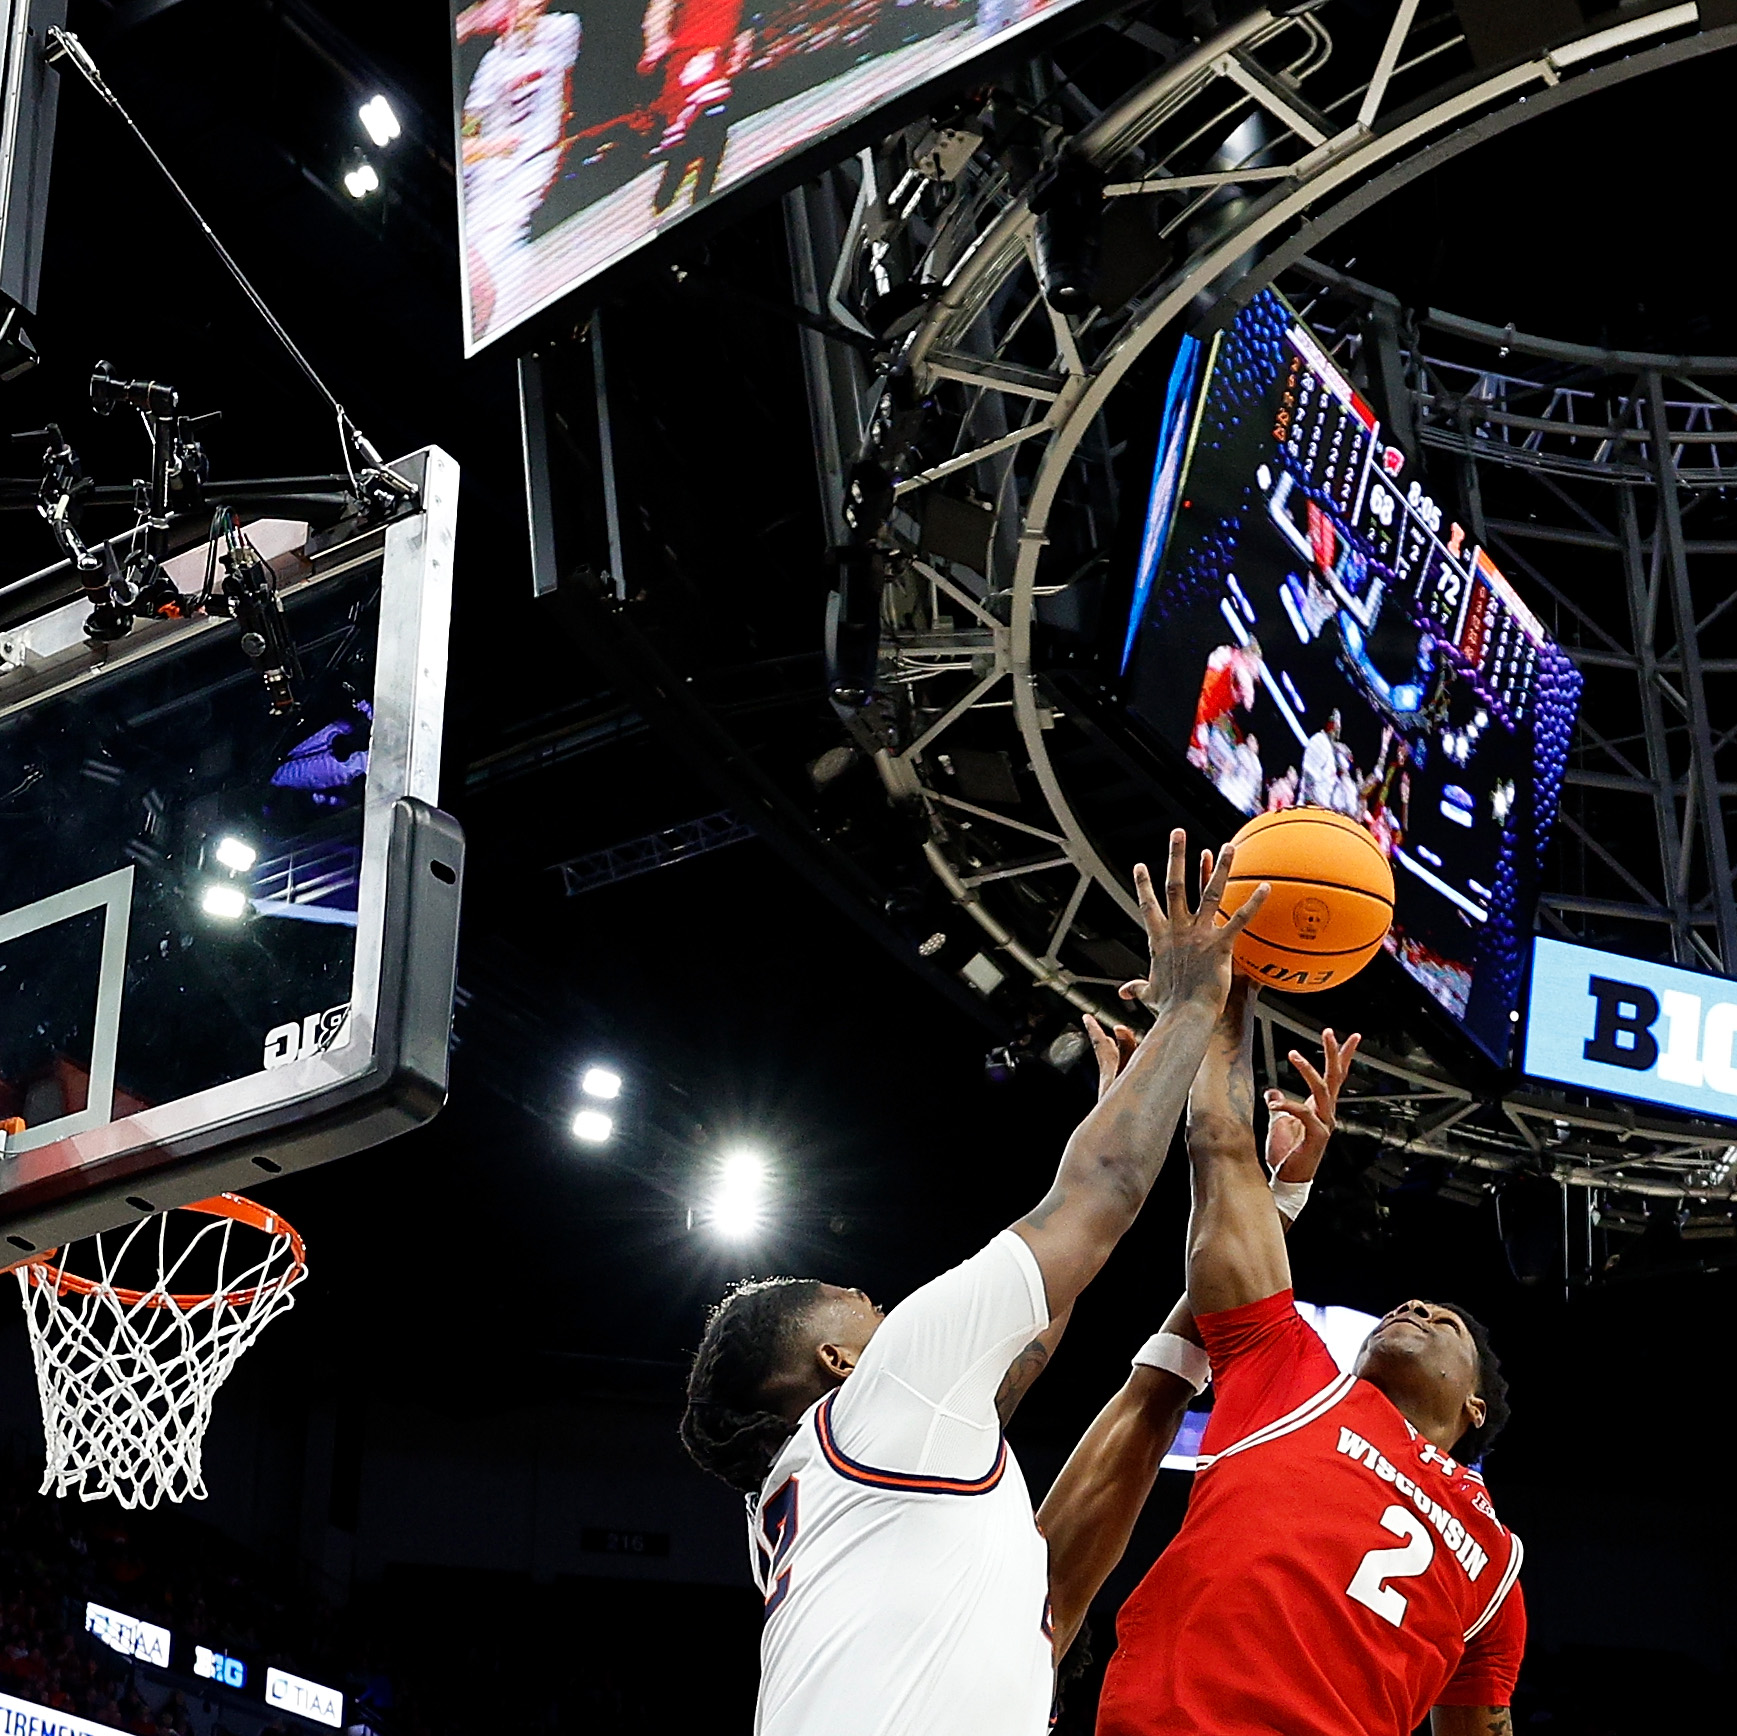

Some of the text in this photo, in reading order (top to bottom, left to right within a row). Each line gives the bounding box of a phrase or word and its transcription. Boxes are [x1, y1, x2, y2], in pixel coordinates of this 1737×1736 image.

[1369, 484, 1393, 526] 68
[1406, 480, 1442, 532] 8:05
[1437, 561, 1461, 605] 72
[1337, 1426, 1490, 1583] WISCONSIN
[1345, 1504, 1436, 1628] 2
[294, 1686, 336, 1719] TIAA
